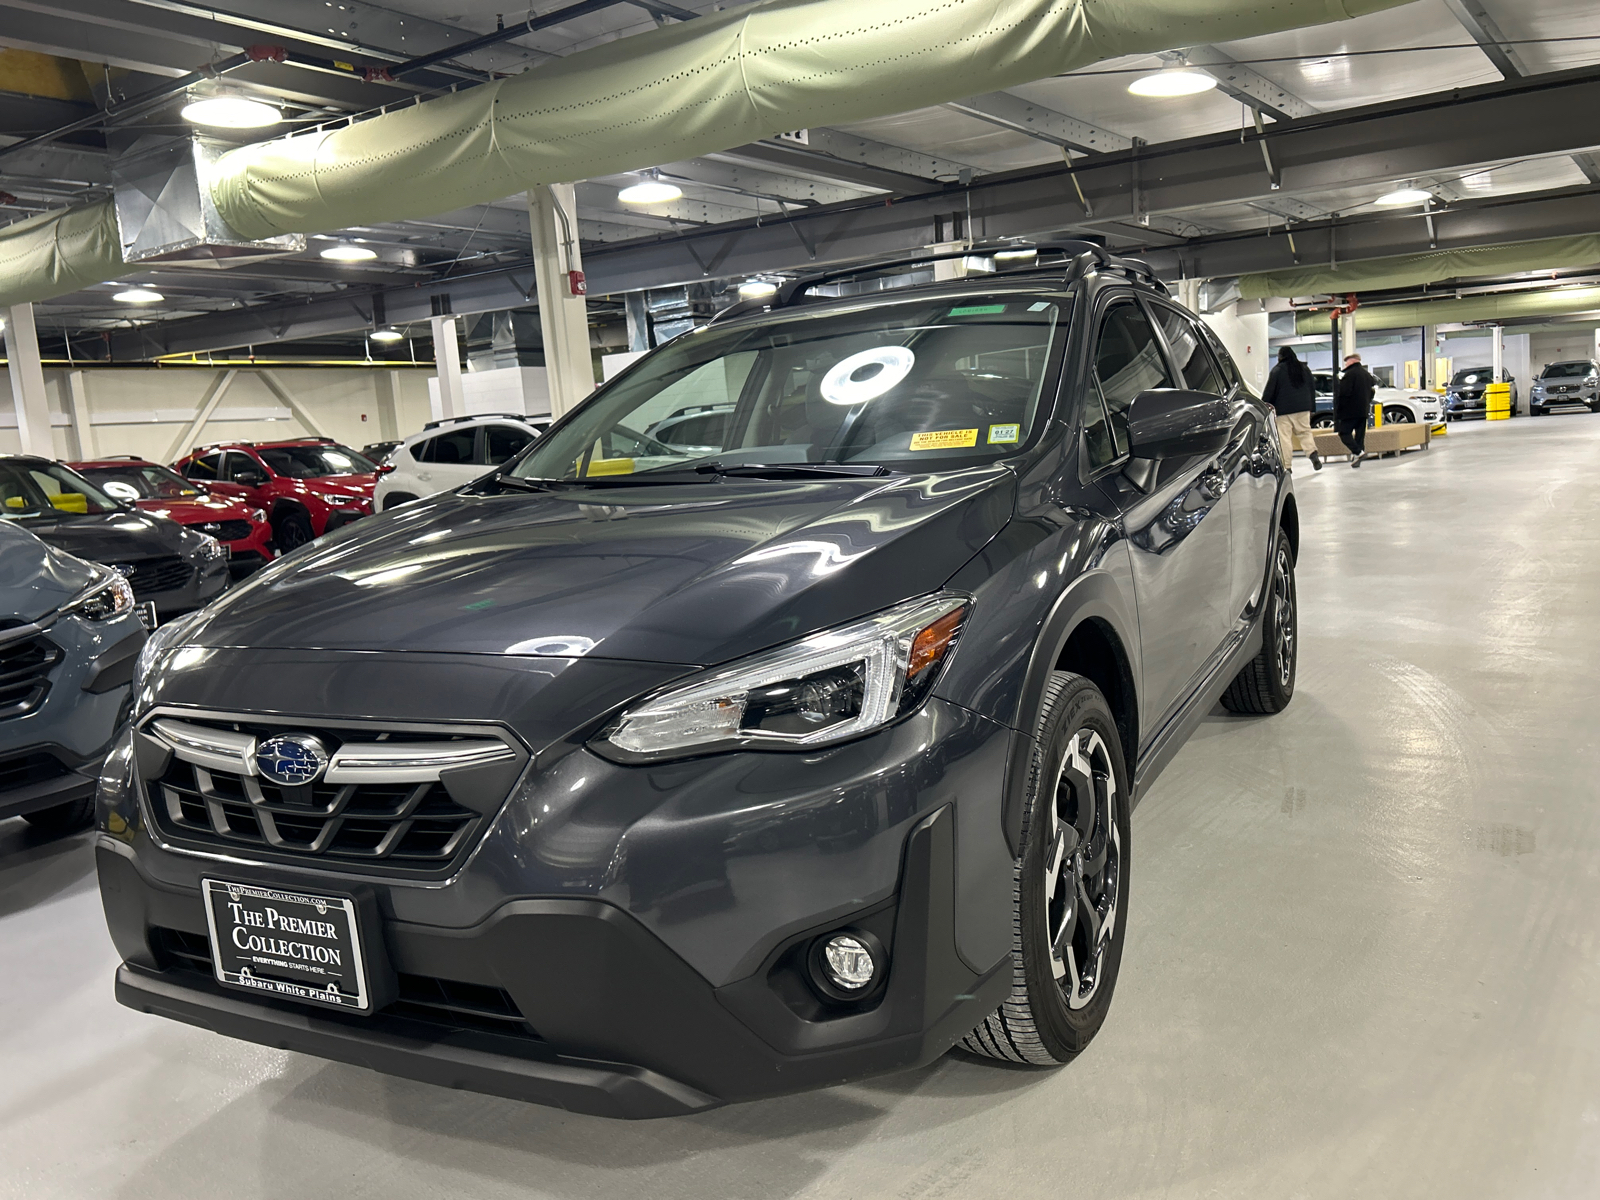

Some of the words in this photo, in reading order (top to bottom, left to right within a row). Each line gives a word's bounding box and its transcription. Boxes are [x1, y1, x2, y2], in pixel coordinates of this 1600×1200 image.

[252, 956, 289, 968] EVERYTHING
[238, 976, 274, 990] Subaru
[276, 983, 306, 996] White
[308, 989, 342, 1003] Plains
